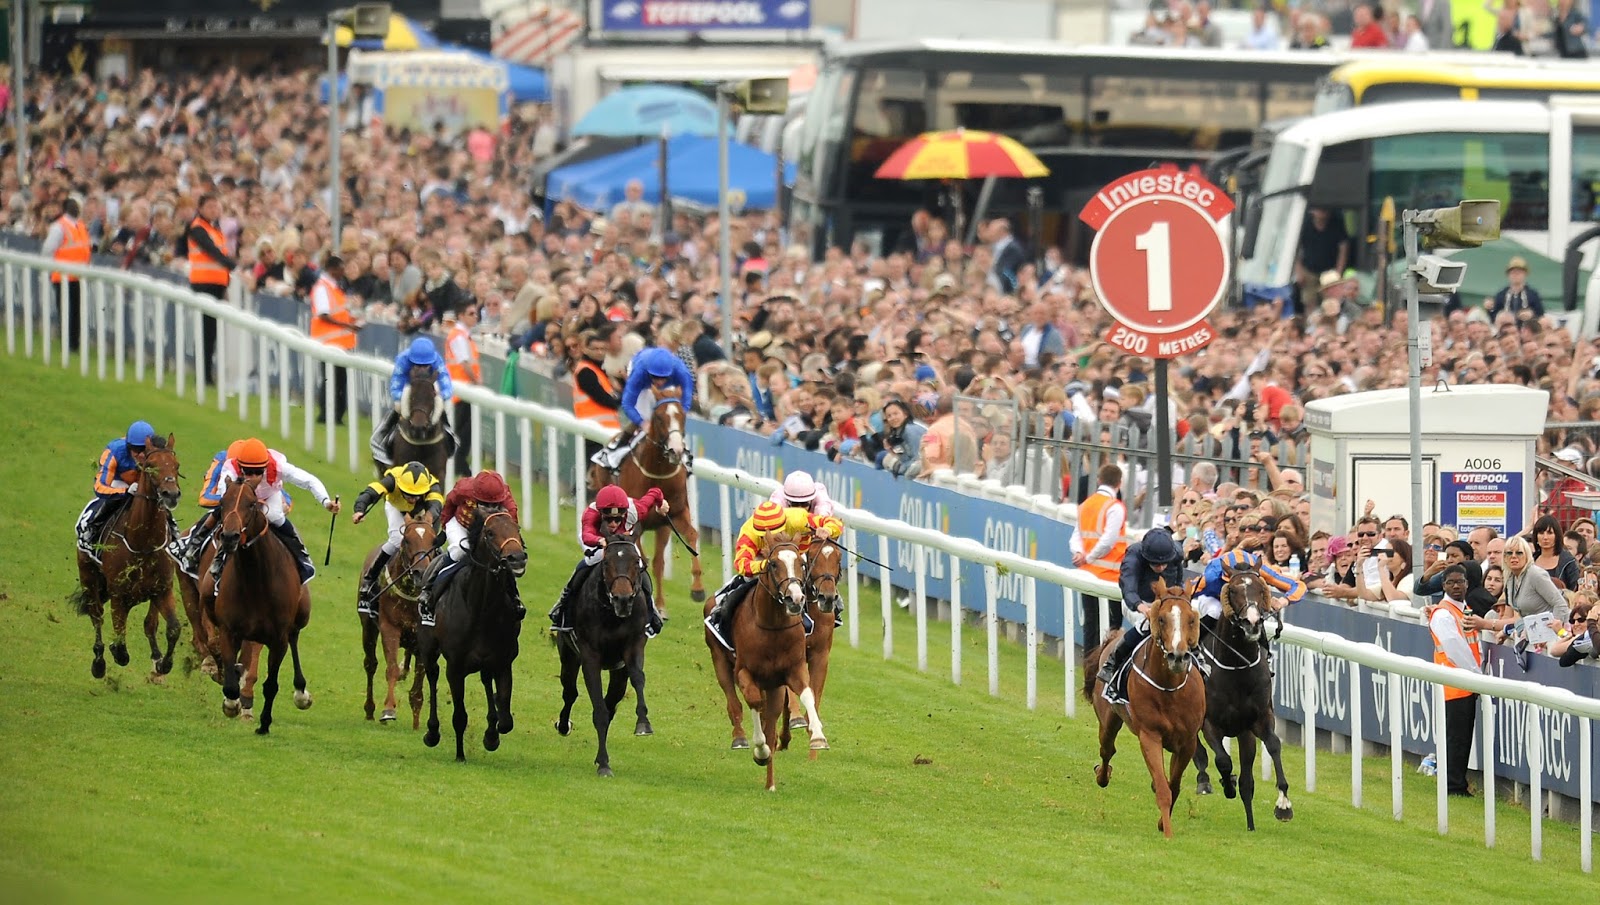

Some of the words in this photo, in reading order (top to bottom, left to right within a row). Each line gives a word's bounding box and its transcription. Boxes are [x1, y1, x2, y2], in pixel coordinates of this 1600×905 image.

[1098, 173, 1215, 212] Investec
[1135, 221, 1172, 312] 1
[1111, 328, 1148, 354] 200
[1158, 328, 1211, 355] METRES
[1464, 458, 1501, 469] A006
[1455, 474, 1509, 483] TOTEPOOL
[1460, 494, 1497, 502] totejackpot
